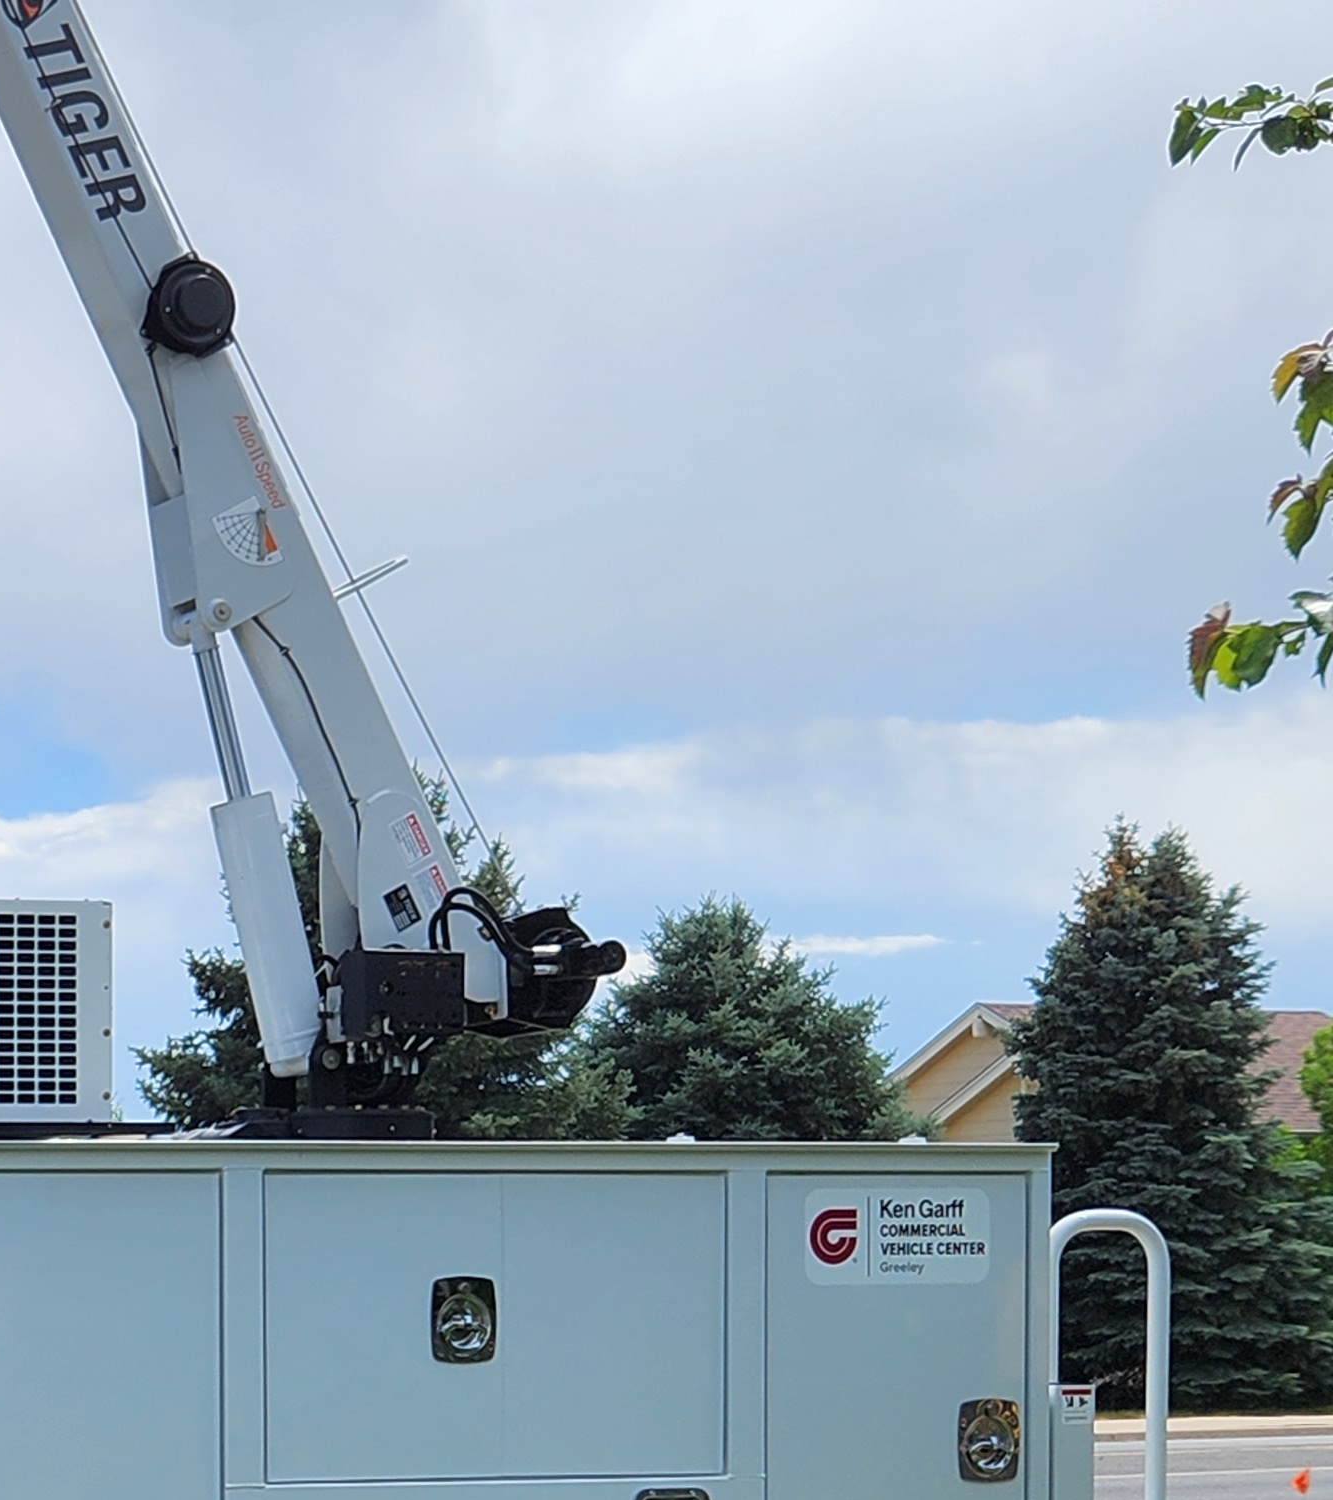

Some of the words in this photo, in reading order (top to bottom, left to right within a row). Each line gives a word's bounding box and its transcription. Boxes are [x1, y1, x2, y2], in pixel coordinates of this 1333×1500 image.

[23, 23, 147, 222] TIGER
[255, 461, 286, 509] Speed
[879, 1198, 916, 1219] Ken
[918, 1198, 965, 1219] Garff
[879, 1223, 966, 1238] COMMERCIAL
[880, 1242, 934, 1256] VEHICLE
[936, 1241, 986, 1255] CENTER
[879, 1261, 925, 1276] Greeley
